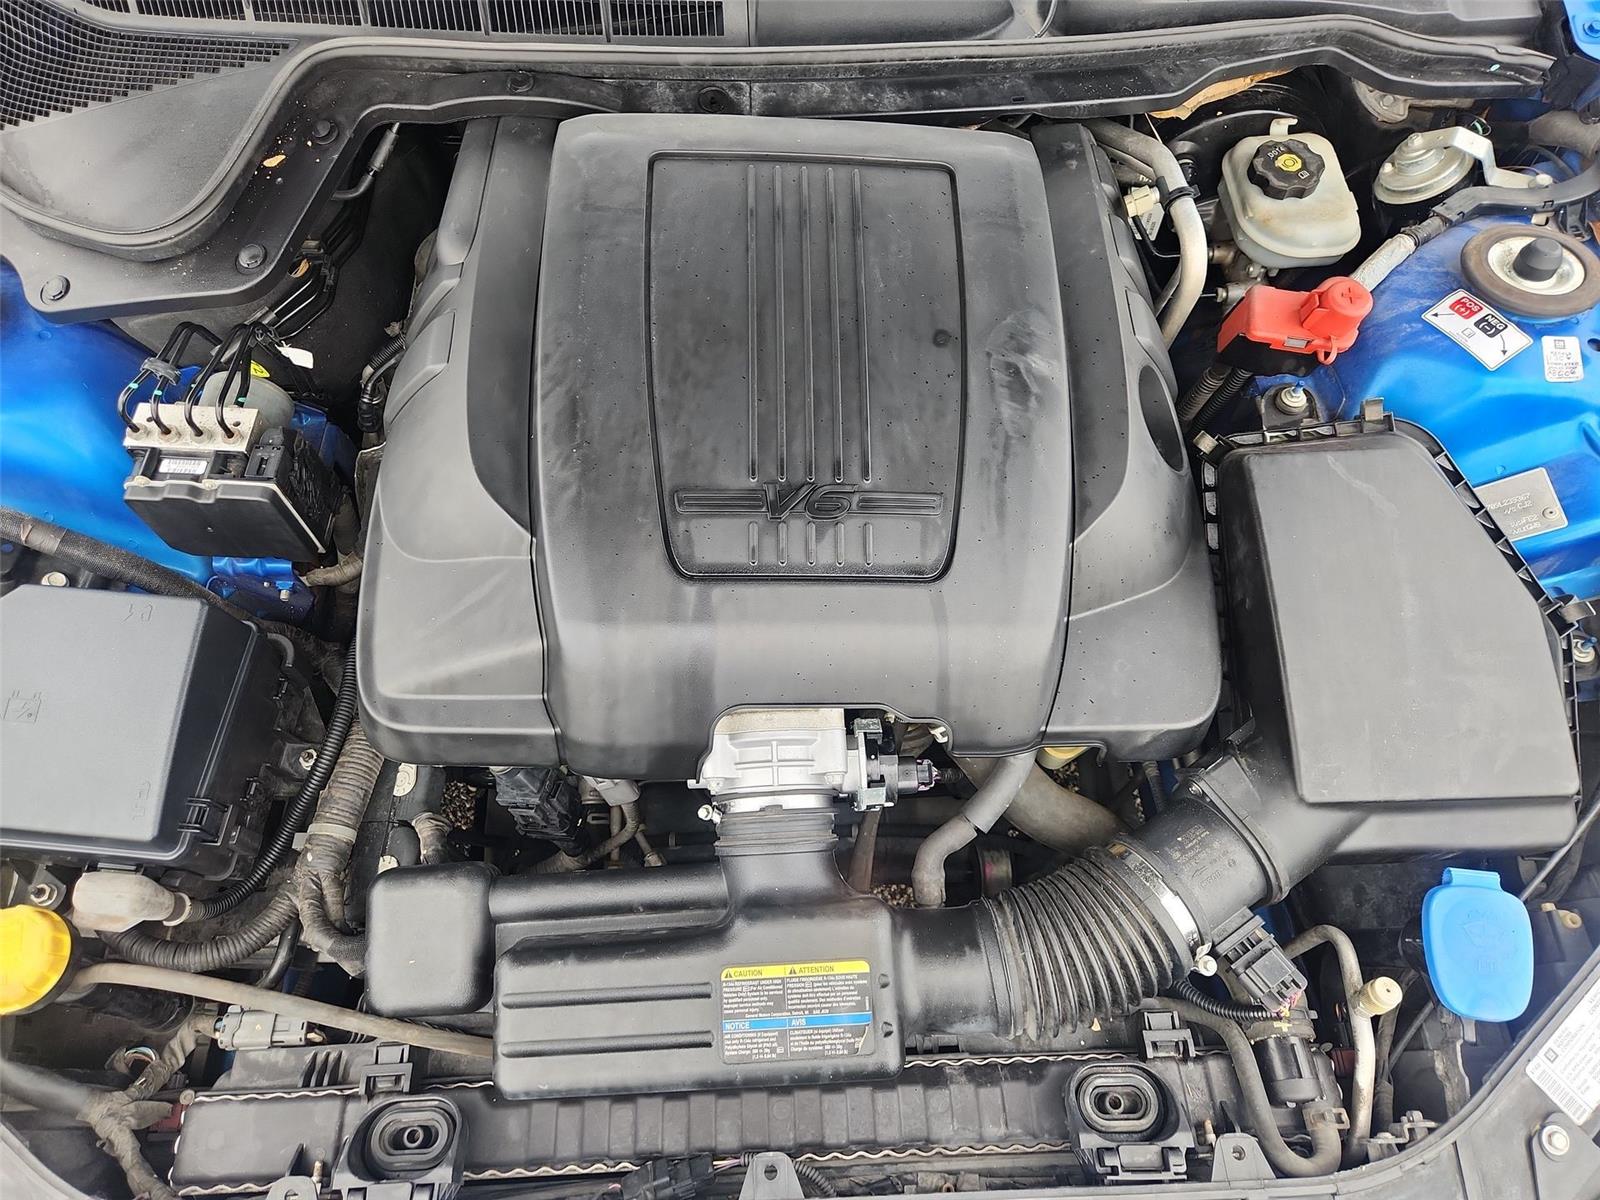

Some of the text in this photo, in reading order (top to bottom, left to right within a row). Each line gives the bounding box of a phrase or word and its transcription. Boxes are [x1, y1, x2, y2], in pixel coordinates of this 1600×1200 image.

[1460, 297, 1481, 313] POS
[1485, 314, 1506, 331] NEG
[762, 482, 859, 522] V6
[733, 969, 762, 977] CAUTION
[798, 965, 833, 974] ATTENTION
[724, 1021, 749, 1030] NOTICE
[791, 1018, 806, 1026] AVIS
